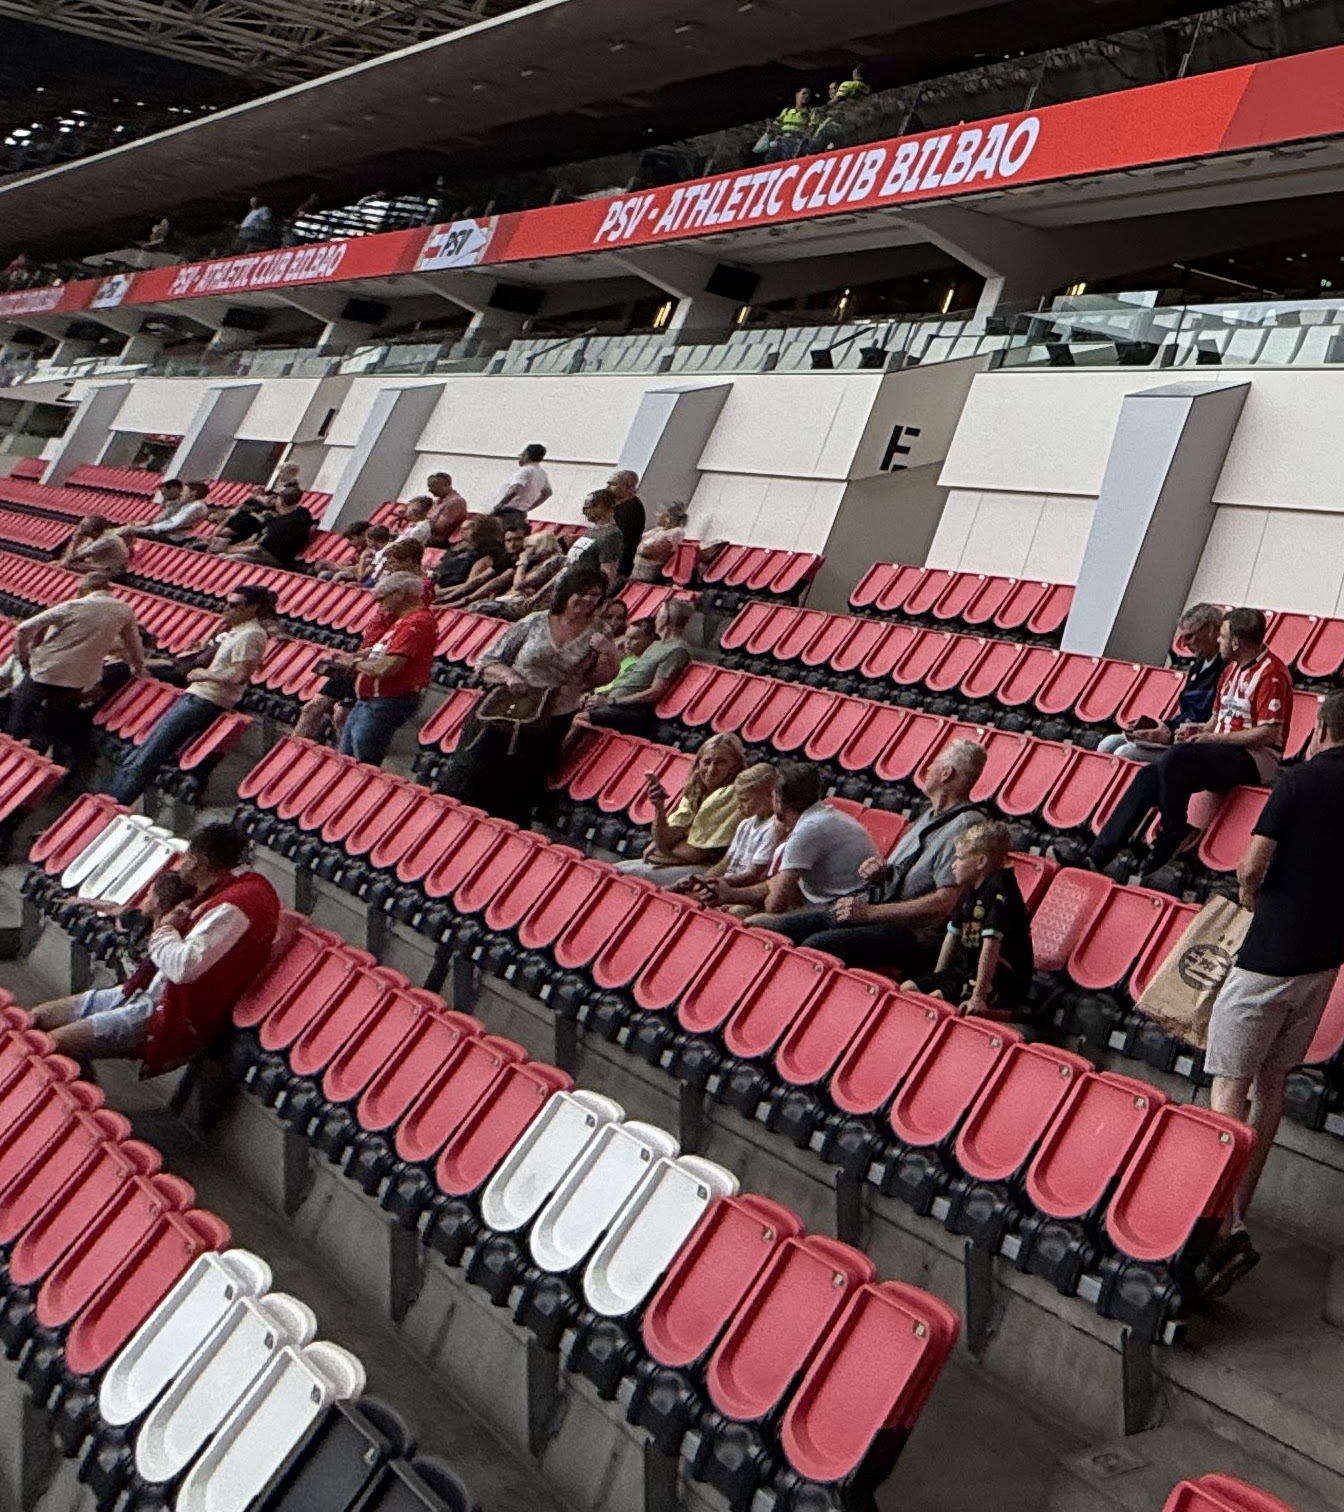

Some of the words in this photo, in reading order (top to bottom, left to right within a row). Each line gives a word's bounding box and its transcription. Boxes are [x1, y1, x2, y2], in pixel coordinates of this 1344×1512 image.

[592, 193, 656, 244] PSV
[652, 164, 801, 235] ATHLETIC
[791, 148, 887, 212] CLUB
[878, 116, 1041, 198] BILBAO
